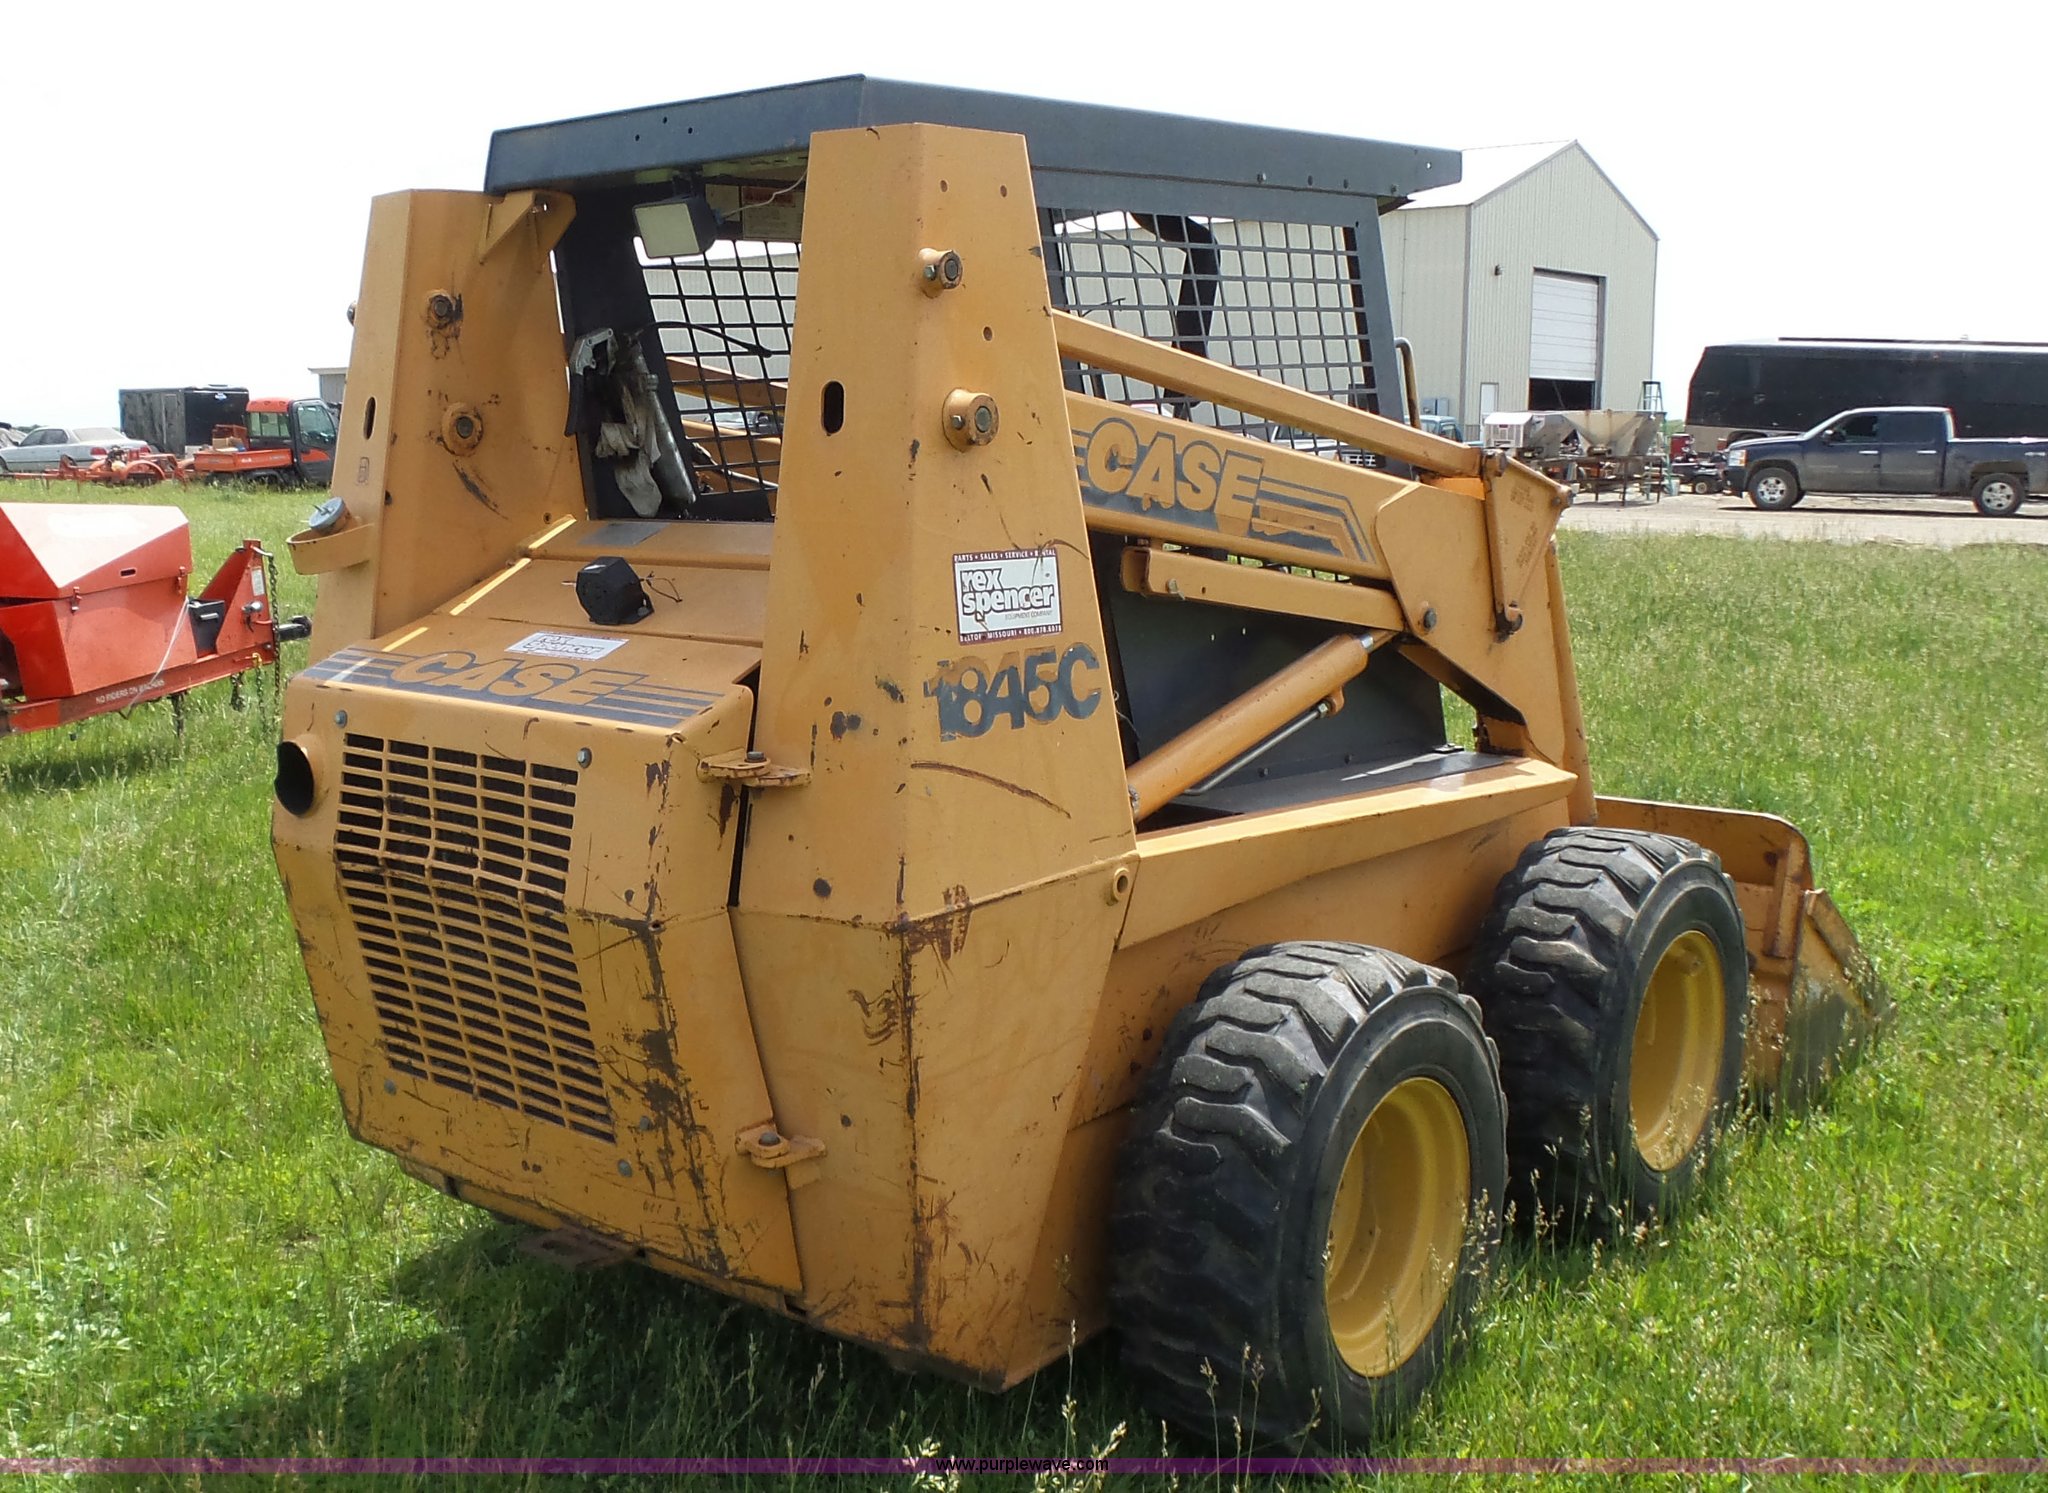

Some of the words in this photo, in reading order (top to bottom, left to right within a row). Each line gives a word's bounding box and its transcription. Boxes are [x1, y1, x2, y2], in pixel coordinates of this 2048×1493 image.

[1087, 417, 1265, 521] CASE
[954, 553, 973, 563] PARTS
[980, 551, 999, 561] SALES
[1004, 550, 1029, 560] SERVICE
[1034, 547, 1056, 557] RNTAL
[960, 568, 1002, 593] rex
[961, 584, 1056, 622] spencer
[987, 628, 1018, 640] MISSOURI
[391, 650, 648, 705] CASE
[923, 641, 1101, 742] 1845C
